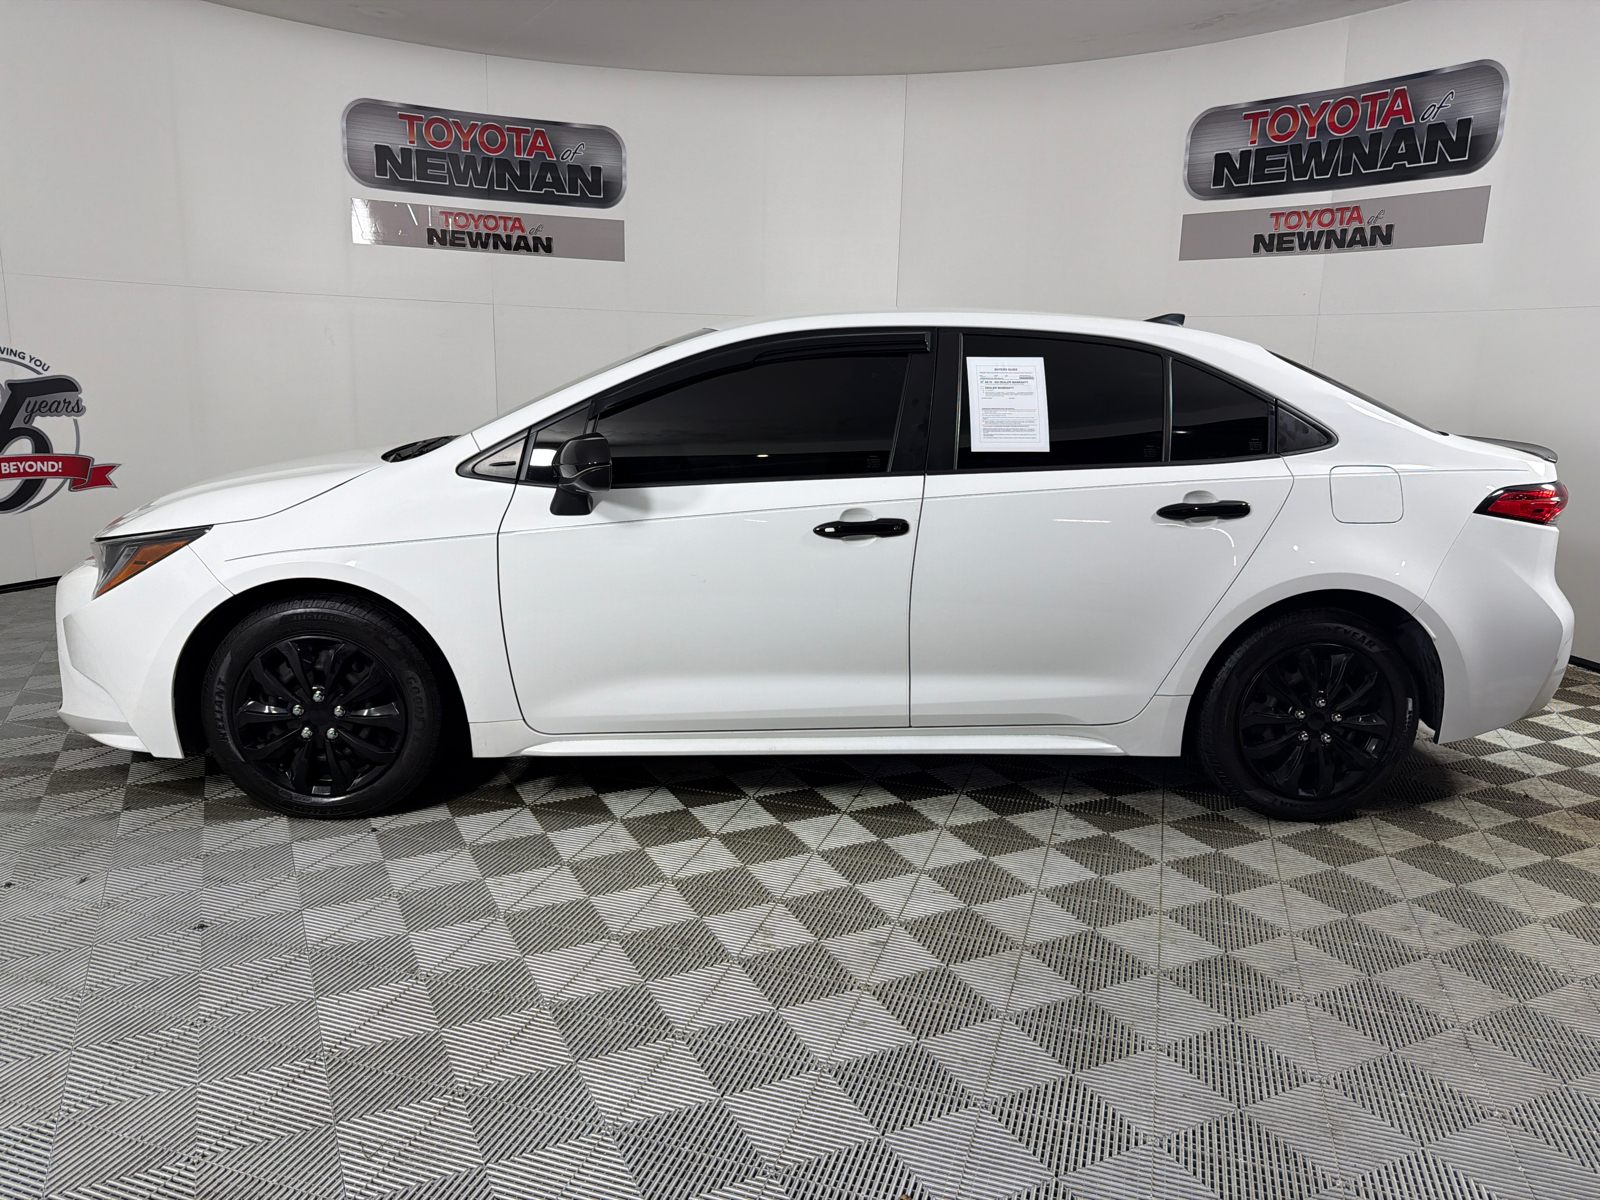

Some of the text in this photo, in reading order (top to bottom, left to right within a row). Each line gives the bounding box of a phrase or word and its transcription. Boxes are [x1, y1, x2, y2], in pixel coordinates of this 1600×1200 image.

[1243, 86, 1456, 145] TOYOTA of
[397, 111, 585, 162] TOYOTA of
[1211, 116, 1474, 189] NEWNAN
[374, 143, 603, 198] NEWNAN
[439, 210, 544, 235] TOYOTA of
[1270, 206, 1385, 232] TOYOTA of
[426, 227, 553, 254] NEWNAN
[1252, 223, 1395, 255] NEWNAN
[29, 354, 50, 372] YOU
[23, 398, 83, 425] years
[1, 461, 63, 474] BEYOND!
